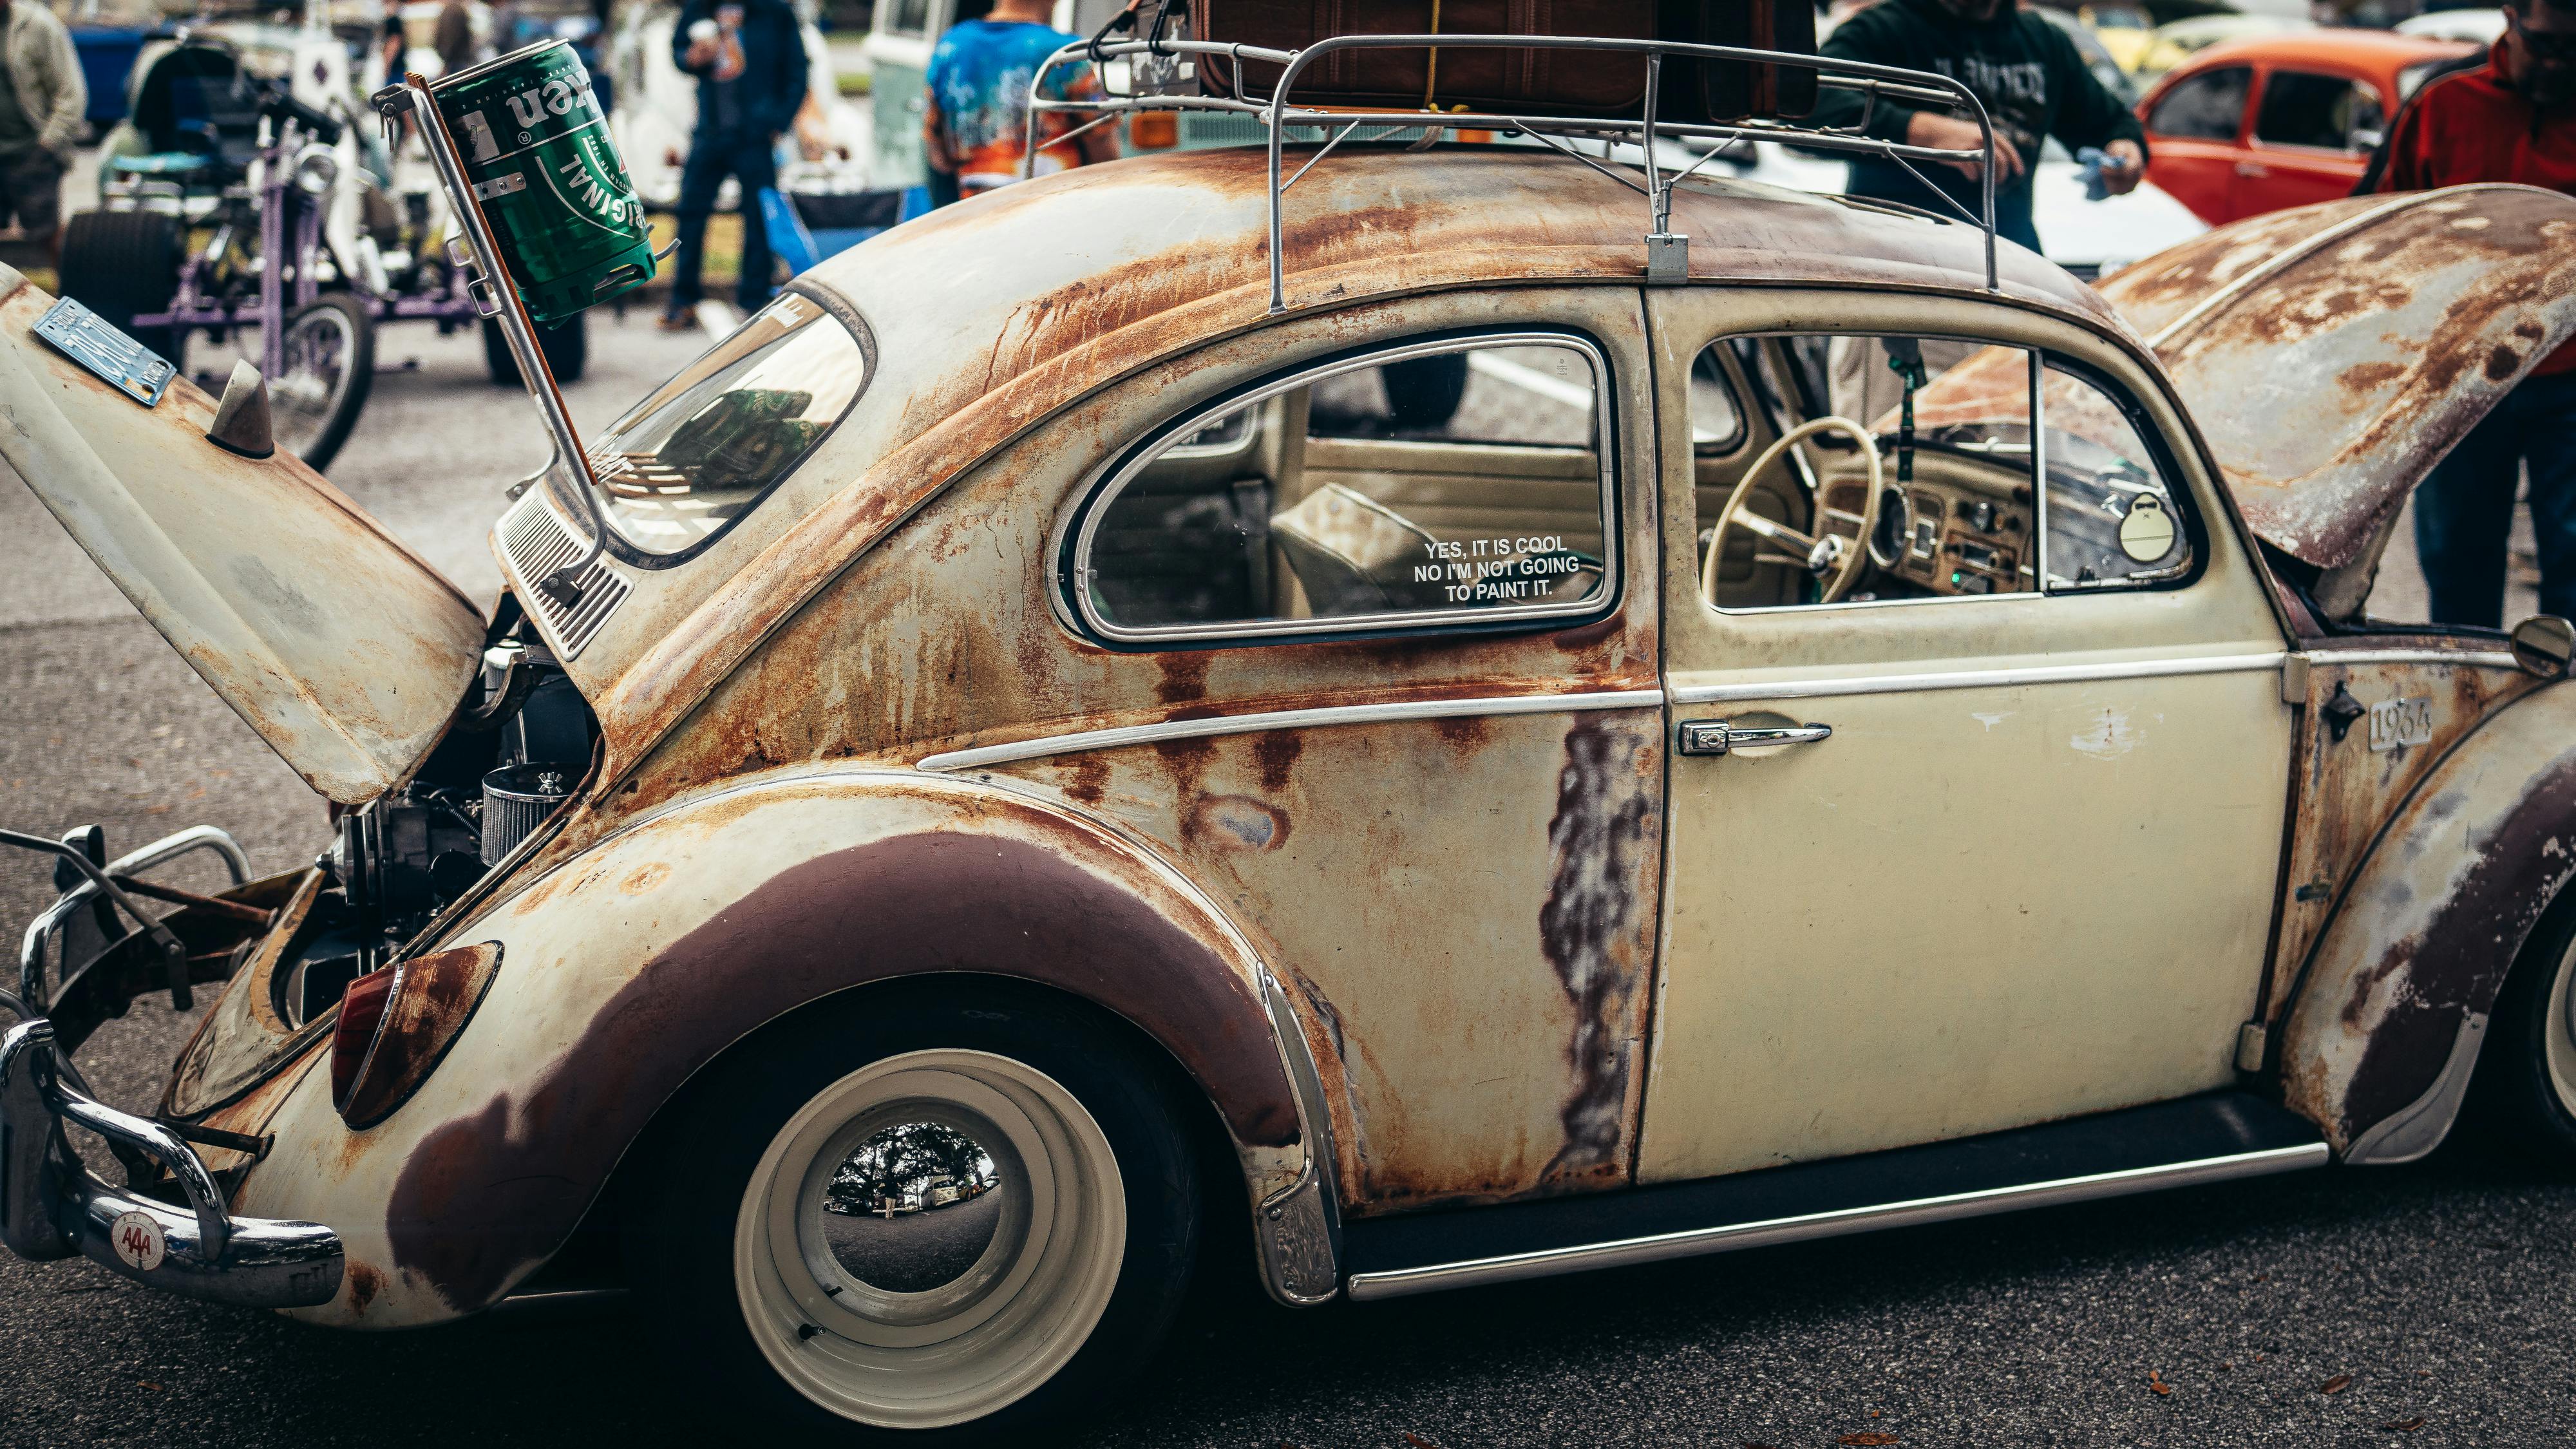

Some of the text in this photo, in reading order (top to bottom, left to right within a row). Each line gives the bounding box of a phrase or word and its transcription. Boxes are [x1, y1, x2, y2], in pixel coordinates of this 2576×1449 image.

[559, 153, 648, 229] RIGINAL
[1425, 536, 1567, 560] YES, IT IS COOL
[1414, 556, 1579, 582] NO I'M NOT GOING
[1445, 580, 1553, 602] TO PAINT IT.
[122, 1226, 151, 1258] AAA
